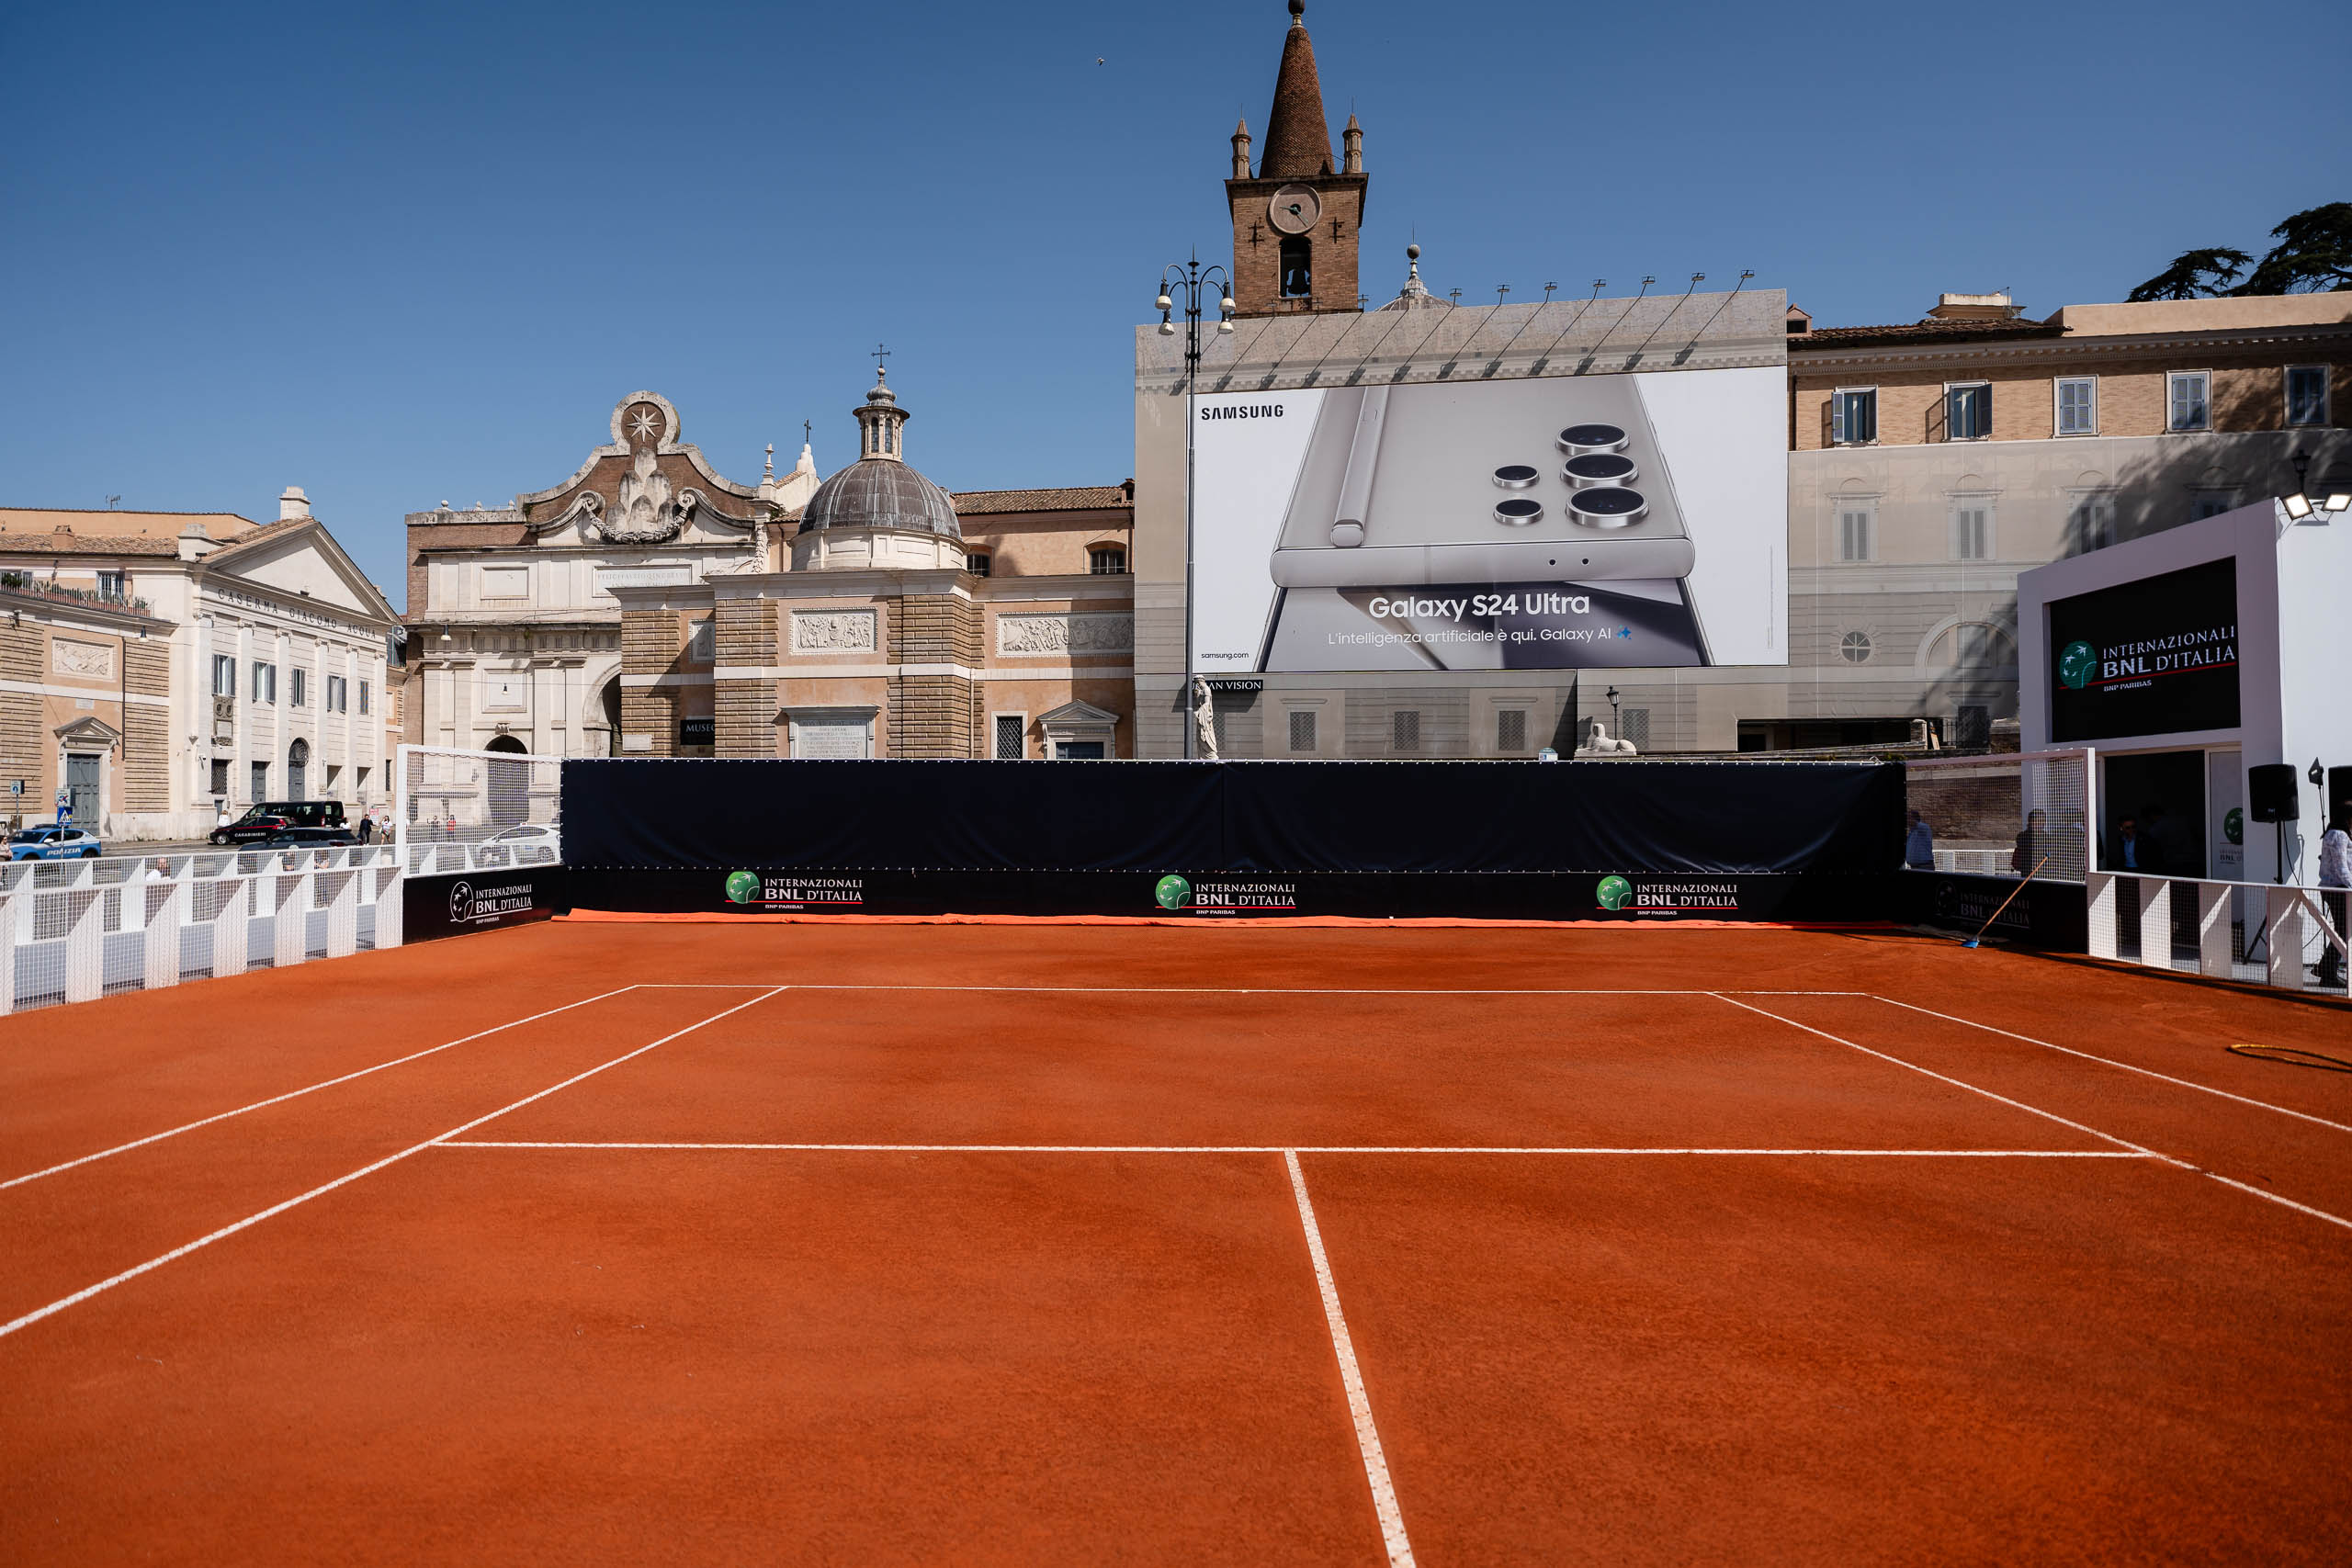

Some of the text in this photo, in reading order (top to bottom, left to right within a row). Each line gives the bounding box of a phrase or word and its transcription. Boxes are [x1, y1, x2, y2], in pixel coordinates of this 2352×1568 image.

[1202, 404, 1283, 421] SAMSUNG
[218, 588, 278, 614] CASERMA
[289, 607, 337, 629] GIACOMO
[1368, 592, 1589, 622] Galaxy S24 Ultra
[1329, 626, 1611, 648] L'intelligenza artificiale è qui. Galaxy AI
[2103, 625, 2235, 660] INTERNAZIONALI
[2103, 645, 2235, 679] BNL D'ITALIA
[1226, 681, 1261, 690] VISION
[2120, 680, 2152, 690] PARIBAS
[765, 878, 863, 887] INTERNAZIONALI
[1196, 884, 1295, 893] INTERNAZIONALI
[1637, 885, 1737, 893] INTERNAZIONALI
[476, 884, 532, 899] INTERNAZIONALI
[765, 888, 862, 900] BNL D'ITALIA
[476, 897, 532, 914] BNL D'ITALIA
[1196, 894, 1295, 906] BNL D'ITALIA
[1637, 895, 1738, 906] BNL D'ITALIA
[1961, 904, 1985, 918] BNL
